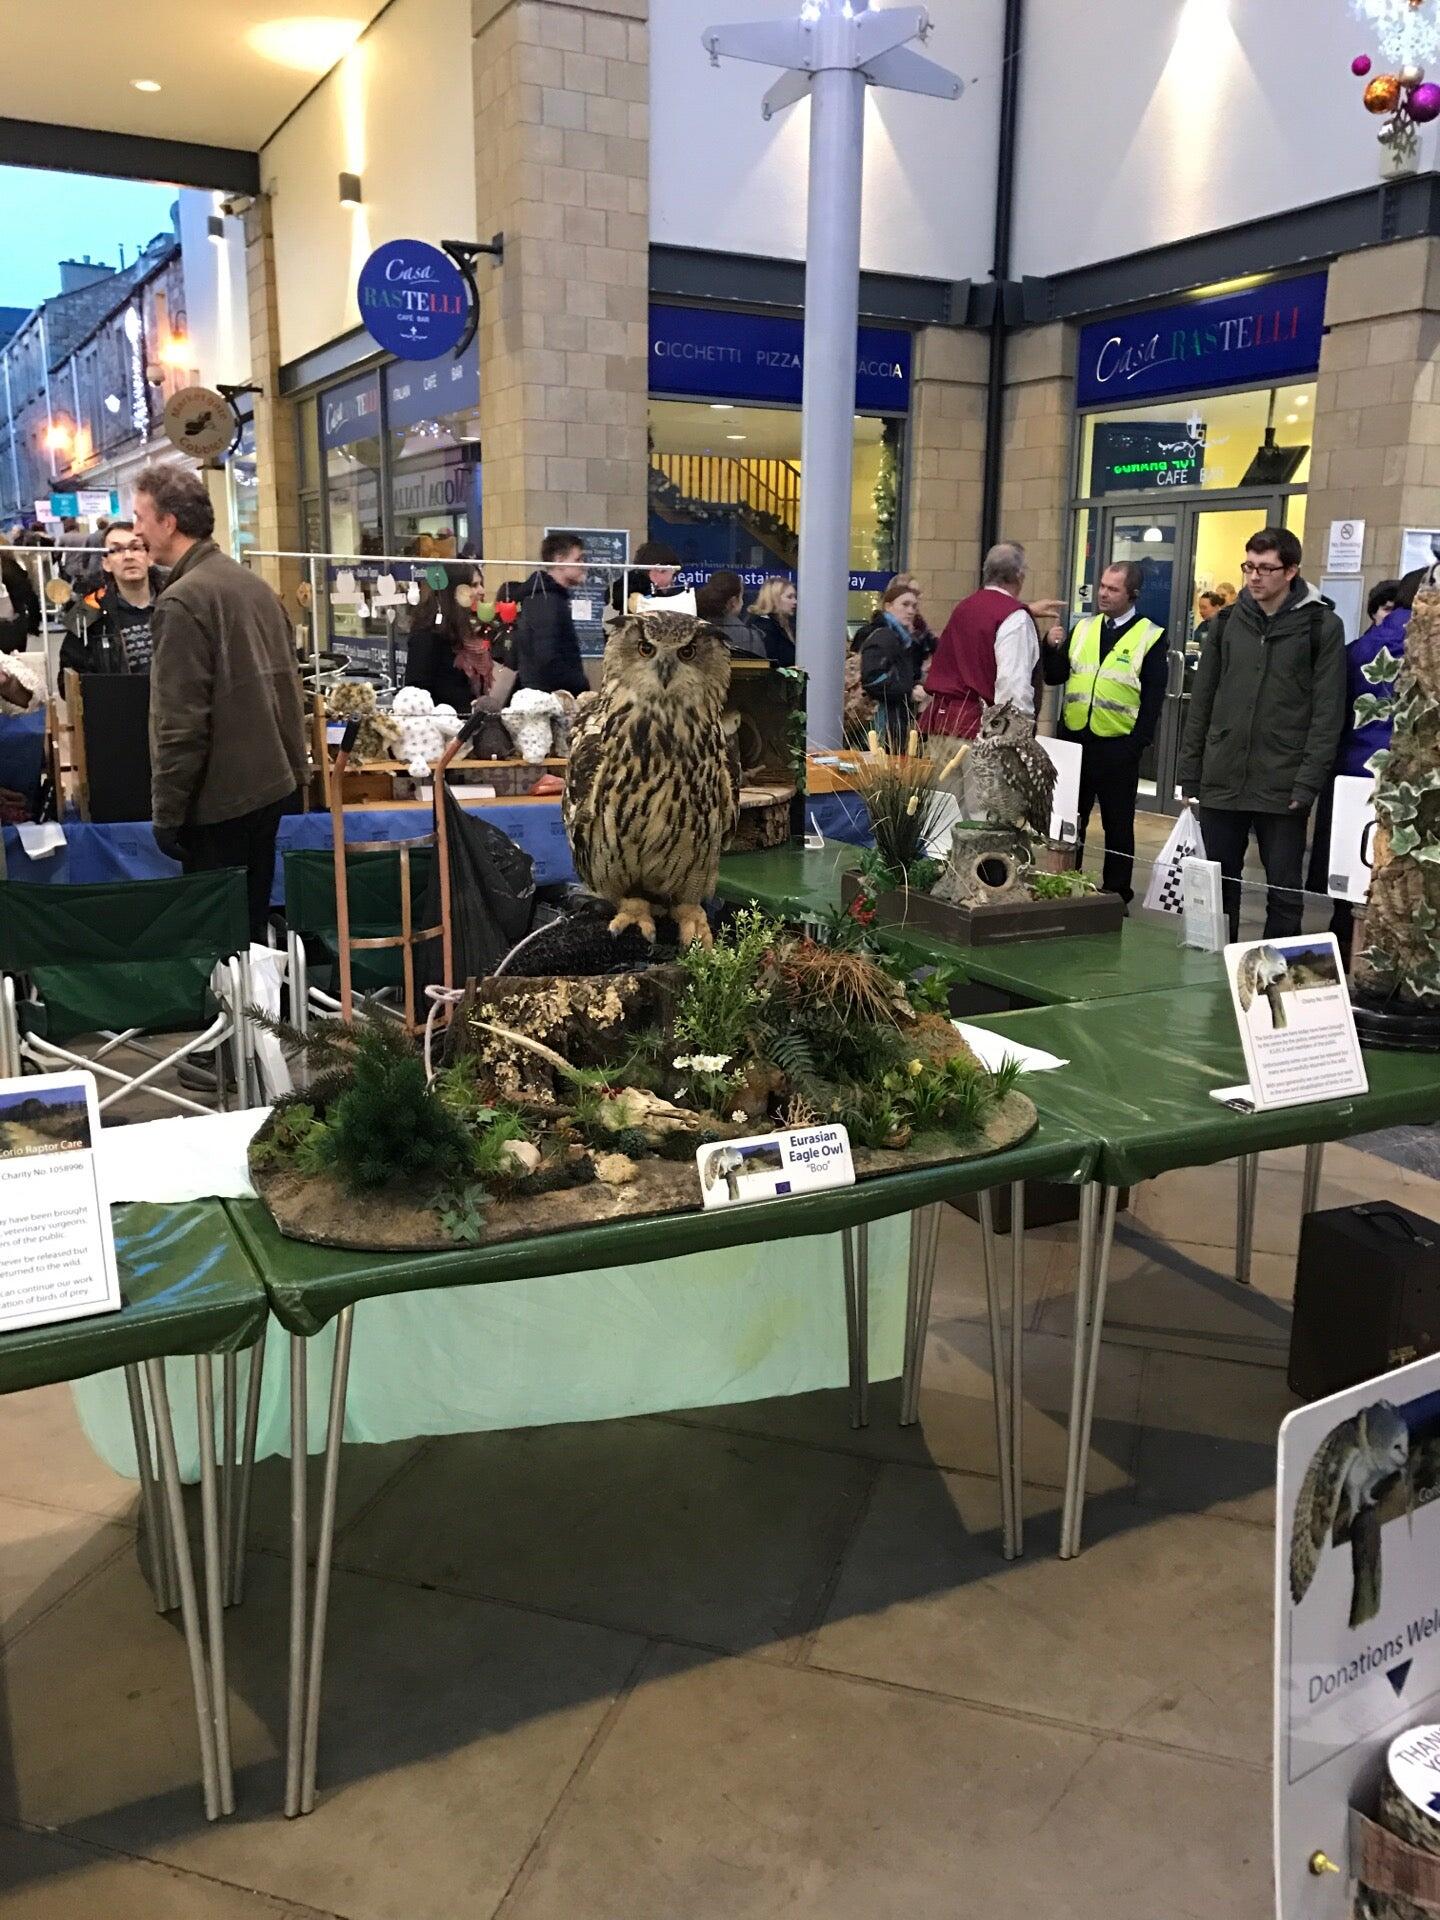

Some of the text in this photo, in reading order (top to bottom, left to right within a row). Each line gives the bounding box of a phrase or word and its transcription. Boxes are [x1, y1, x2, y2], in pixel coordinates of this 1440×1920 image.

[385, 258, 434, 283] Casa
[364, 287, 462, 314] RASTELLI
[1096, 306, 1298, 382] Casa RASTELLI
[654, 340, 903, 379] CICCHETTI PIZZA ACCIA
[673, 570, 712, 584] eatin
[25, 1143, 58, 1154] Raptor
[61, 1140, 83, 1149] Care
[790, 1131, 838, 1147] Eurasian
[789, 1142, 844, 1162] Eagle Owl
[1, 1169, 31, 1180] Charity
[49, 1163, 84, 1174] 1058996
[53, 1206, 88, 1217] brought
[23, 1236, 37, 1244] the
[24, 1255, 35, 1263] be
[37, 1248, 72, 1260] released
[73, 1246, 88, 1255] but
[35, 1264, 46, 1272] to
[47, 1262, 61, 1271] the
[17, 1282, 55, 1295] continue
[56, 1280, 71, 1288] our
[73, 1274, 93, 1285] work
[36, 1292, 57, 1303] birds
[1309, 1607, 1440, 1704] Donations Wel
